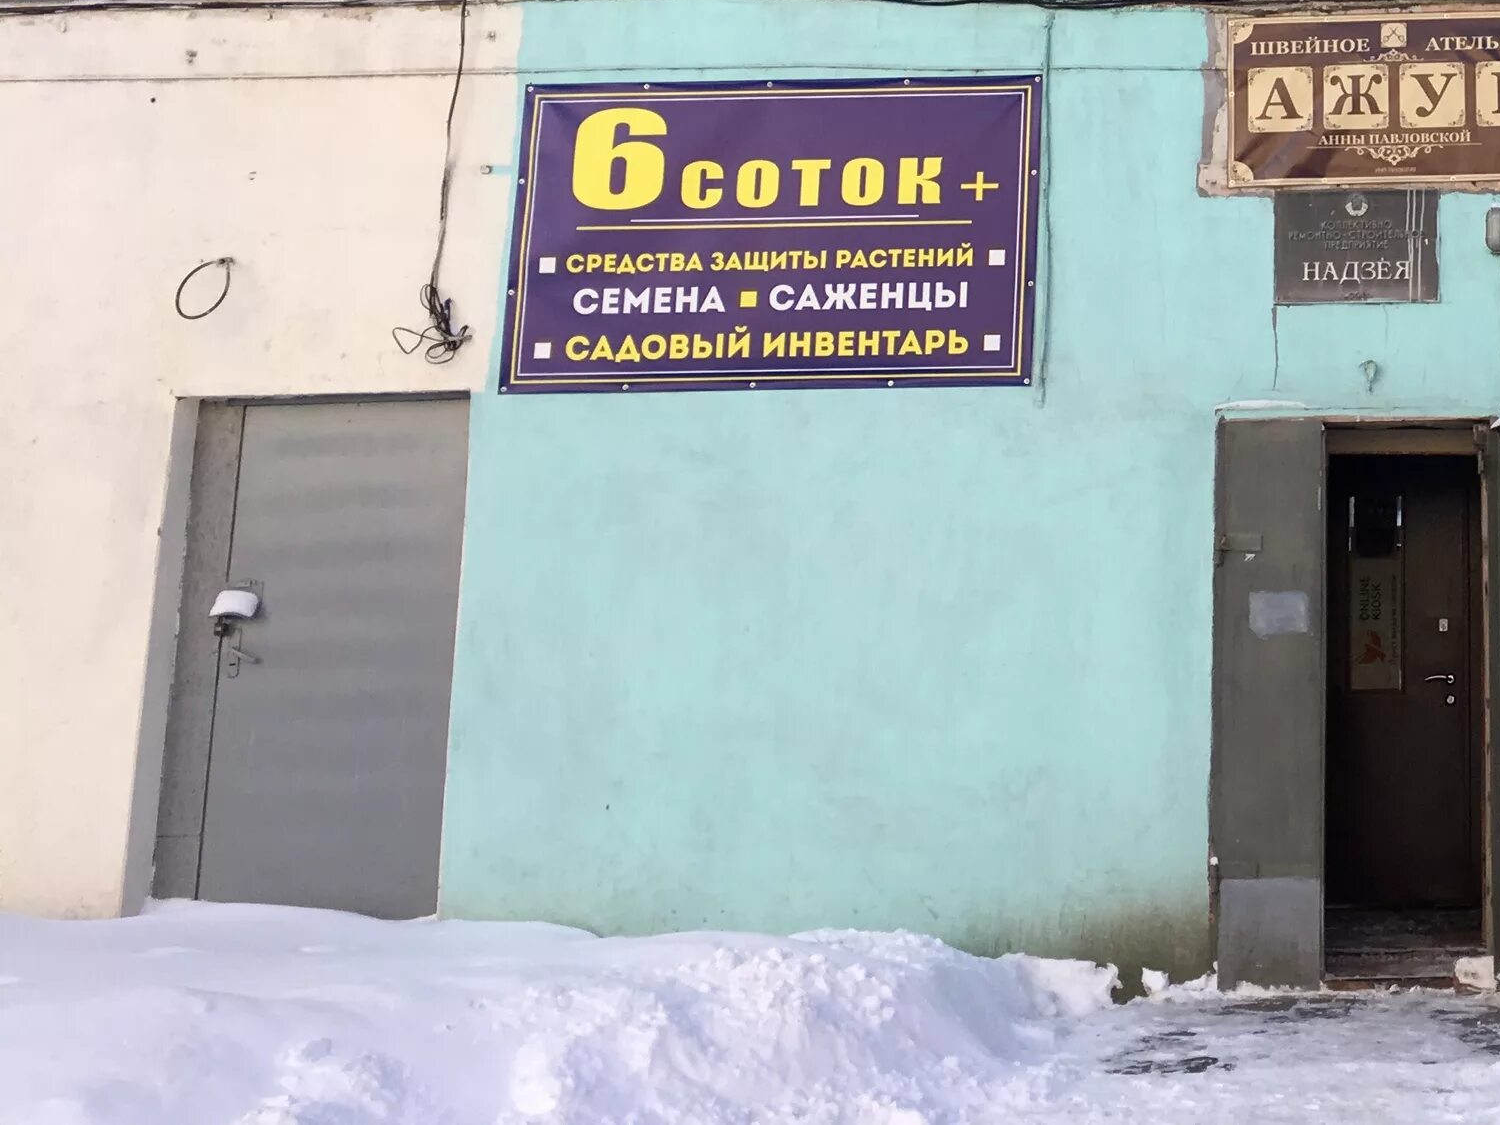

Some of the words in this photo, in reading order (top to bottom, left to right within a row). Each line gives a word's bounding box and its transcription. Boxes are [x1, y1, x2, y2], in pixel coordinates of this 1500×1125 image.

[1250, 36, 1371, 55] ШВЕЙНОЕ
[1318, 133, 1366, 147] АННЫ
[1369, 129, 1472, 146] ПАВЛОВСКОЙ
[572, 107, 668, 211] 6
[680, 155, 943, 210] СОТОК
[565, 250, 704, 275] СРЕДСТВА
[710, 248, 828, 275] ЗАЩИТЫ
[835, 242, 974, 270] РАСТЕНИЙ
[572, 285, 726, 316] СЕМЕНА
[768, 281, 969, 315] САЖЕНЦЫ
[565, 326, 751, 363] САДОВЫЙ
[763, 329, 970, 358] ИНВЕНТАРЬ
